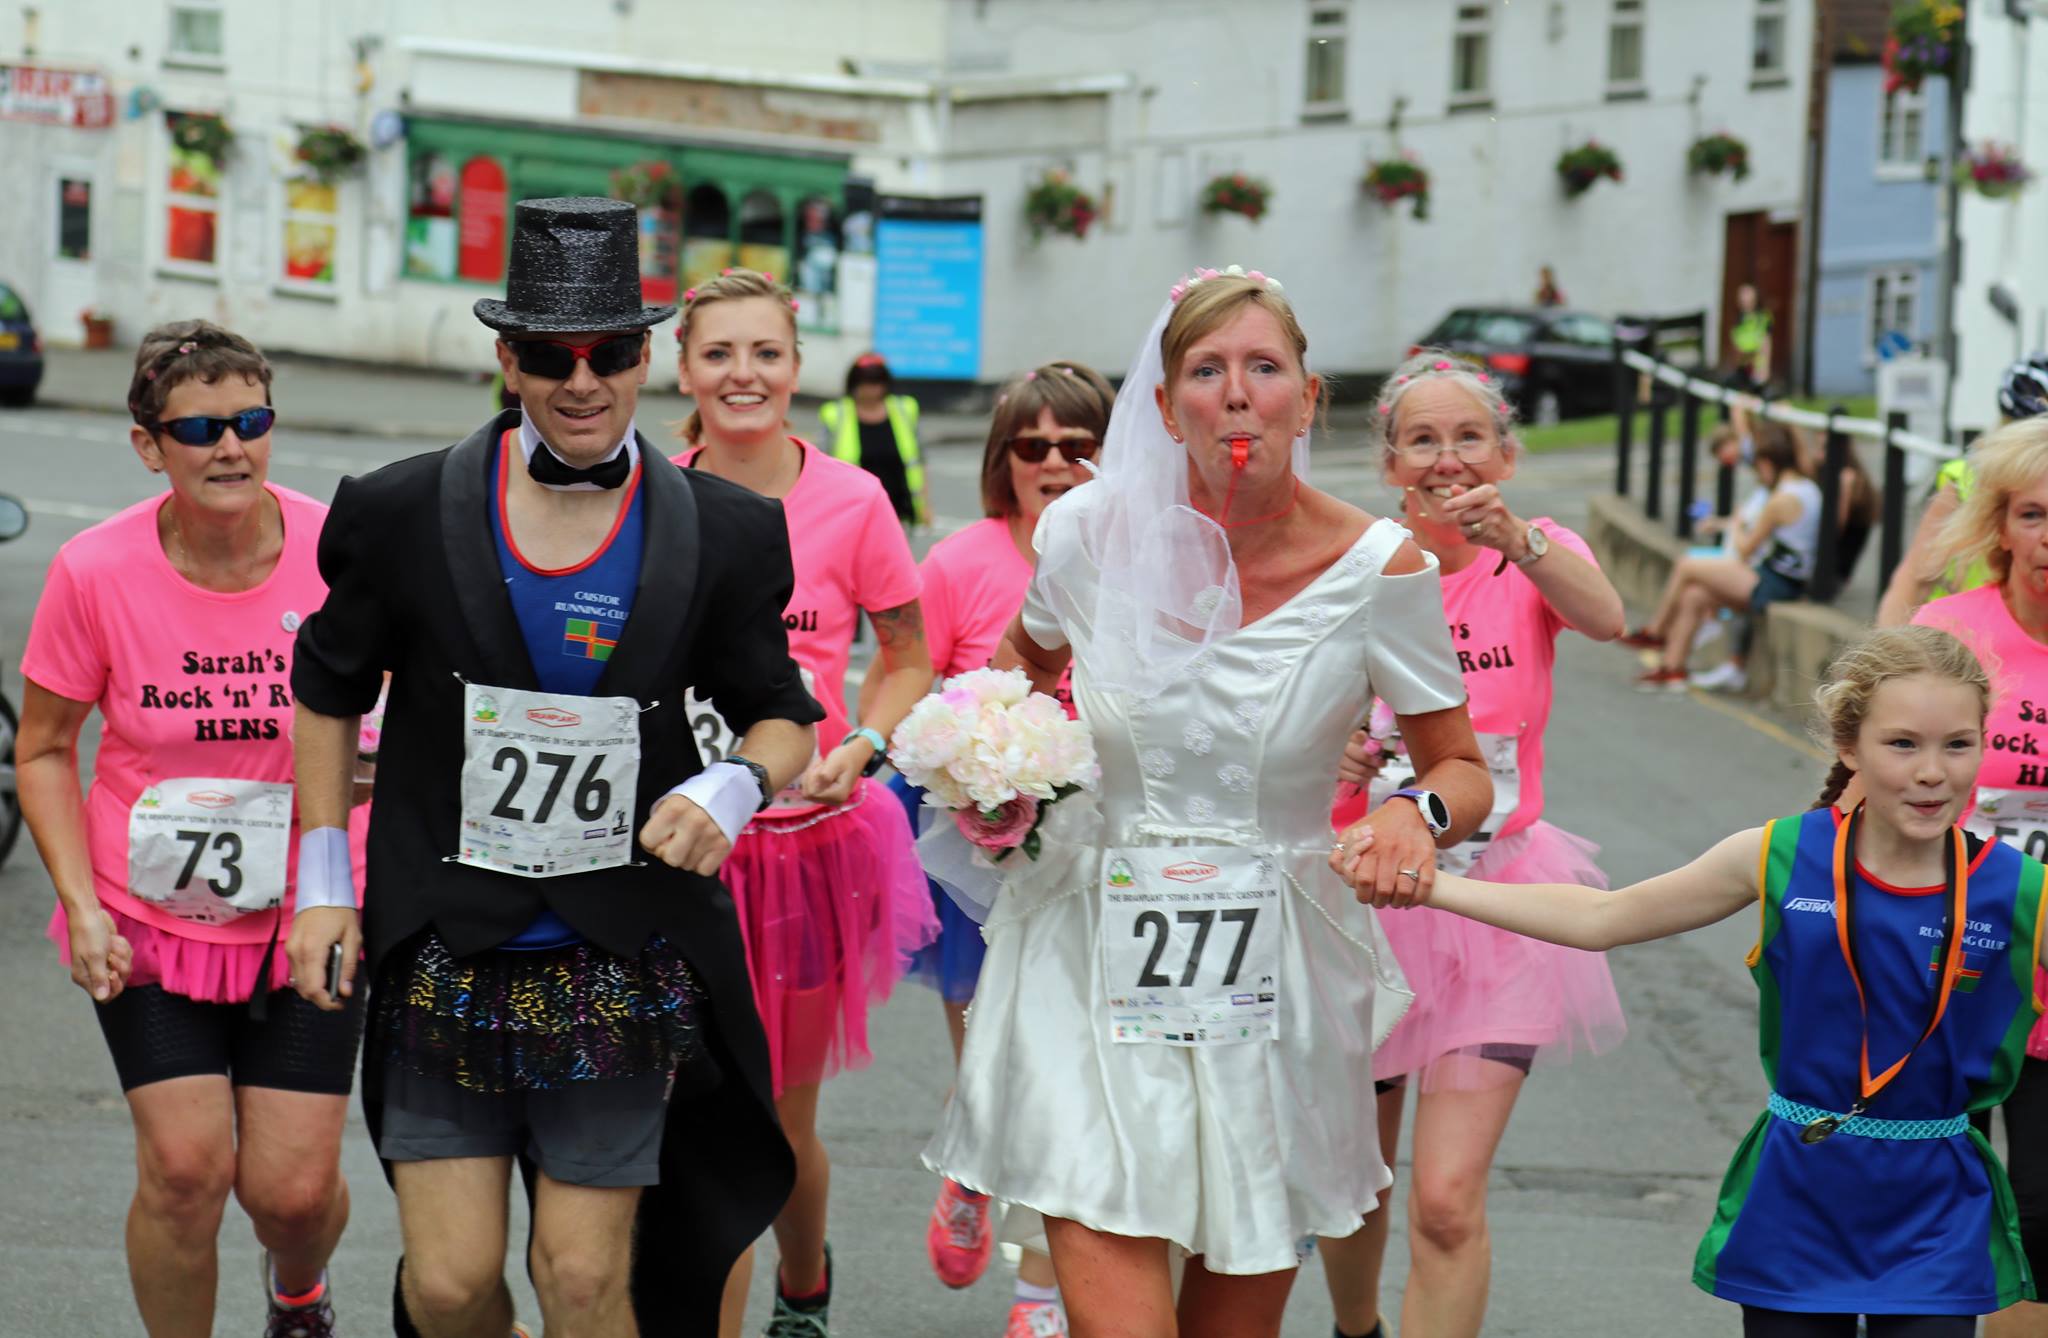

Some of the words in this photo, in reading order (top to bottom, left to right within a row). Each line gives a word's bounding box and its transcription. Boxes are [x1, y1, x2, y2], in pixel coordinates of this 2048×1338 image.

[554, 601, 607, 617] RUNNING
[574, 591, 620, 606] CAISTOR
[785, 610, 818, 632] oll
[182, 648, 286, 675] Sarah's
[1456, 645, 1515, 674] Roll
[140, 684, 214, 709] Rock
[194, 718, 280, 741] HENS
[1988, 733, 2040, 755] ock
[490, 746, 611, 824] 276
[174, 829, 243, 898] 73
[1133, 908, 1260, 988] 277
